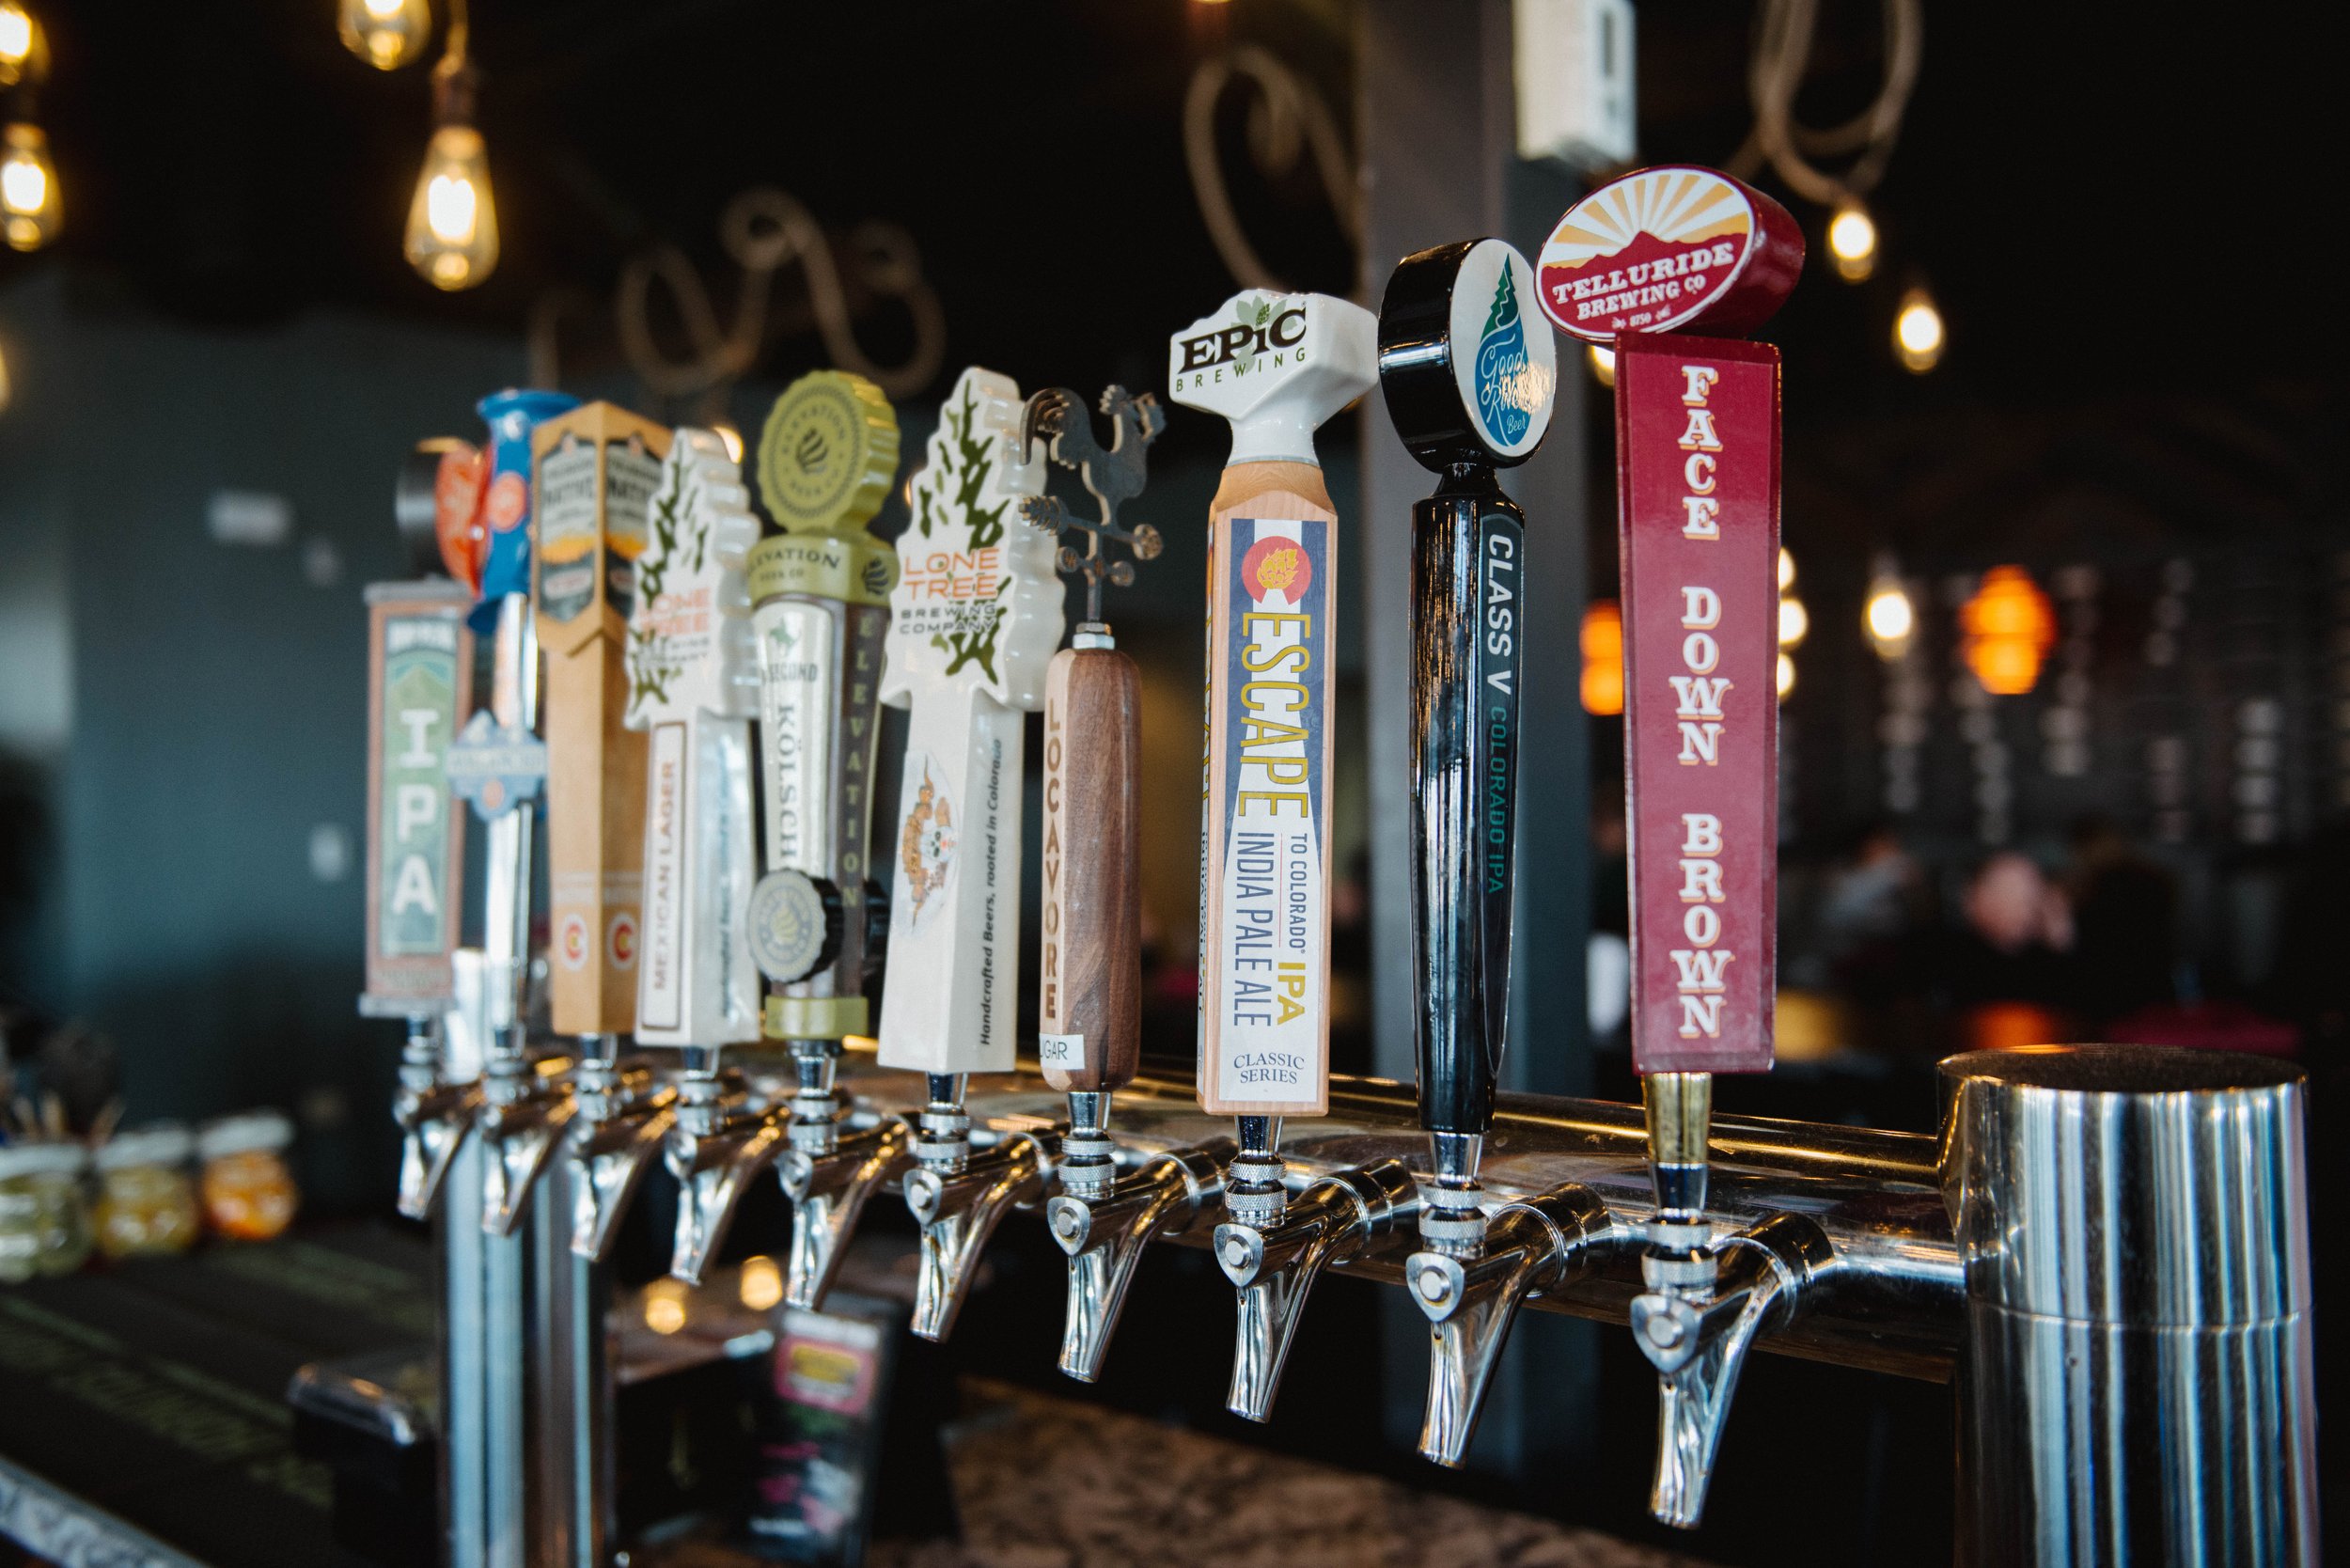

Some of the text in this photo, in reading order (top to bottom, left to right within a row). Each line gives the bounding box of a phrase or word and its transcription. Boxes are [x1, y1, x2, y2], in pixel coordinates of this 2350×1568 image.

[1552, 242, 1735, 305] TELLURIDE
[1576, 281, 1681, 321] BREWING
[1176, 347, 1306, 392] BREWING
[1480, 334, 1526, 405] Good
[1506, 415, 1527, 434] Beer
[1677, 365, 1724, 541] FACE
[903, 574, 998, 602] TREE
[904, 546, 1000, 575] LONE
[900, 619, 995, 635] COMPANY
[901, 604, 996, 619] BREWING
[1668, 586, 1734, 766] DOWN
[1238, 612, 1311, 818] ESCAPE
[1487, 534, 1513, 895] CLASS V COLORADO IPA
[842, 616, 874, 909] ELEVATION
[392, 708, 440, 916] IPA
[1291, 833, 1308, 854] TO
[654, 761, 674, 991] MEXICAN LAGER
[979, 738, 1002, 1046] Handcrafted Beers, rooted in Colorado
[1045, 698, 1061, 1020] LOCAVORE
[1233, 832, 1275, 1027] INDIA PALE ALE
[1669, 813, 1736, 1039] BROWN
[1277, 962, 1307, 1026] IPA
[1233, 1052, 1306, 1071] CLASSIC
[1240, 1069, 1298, 1085] SERIES
